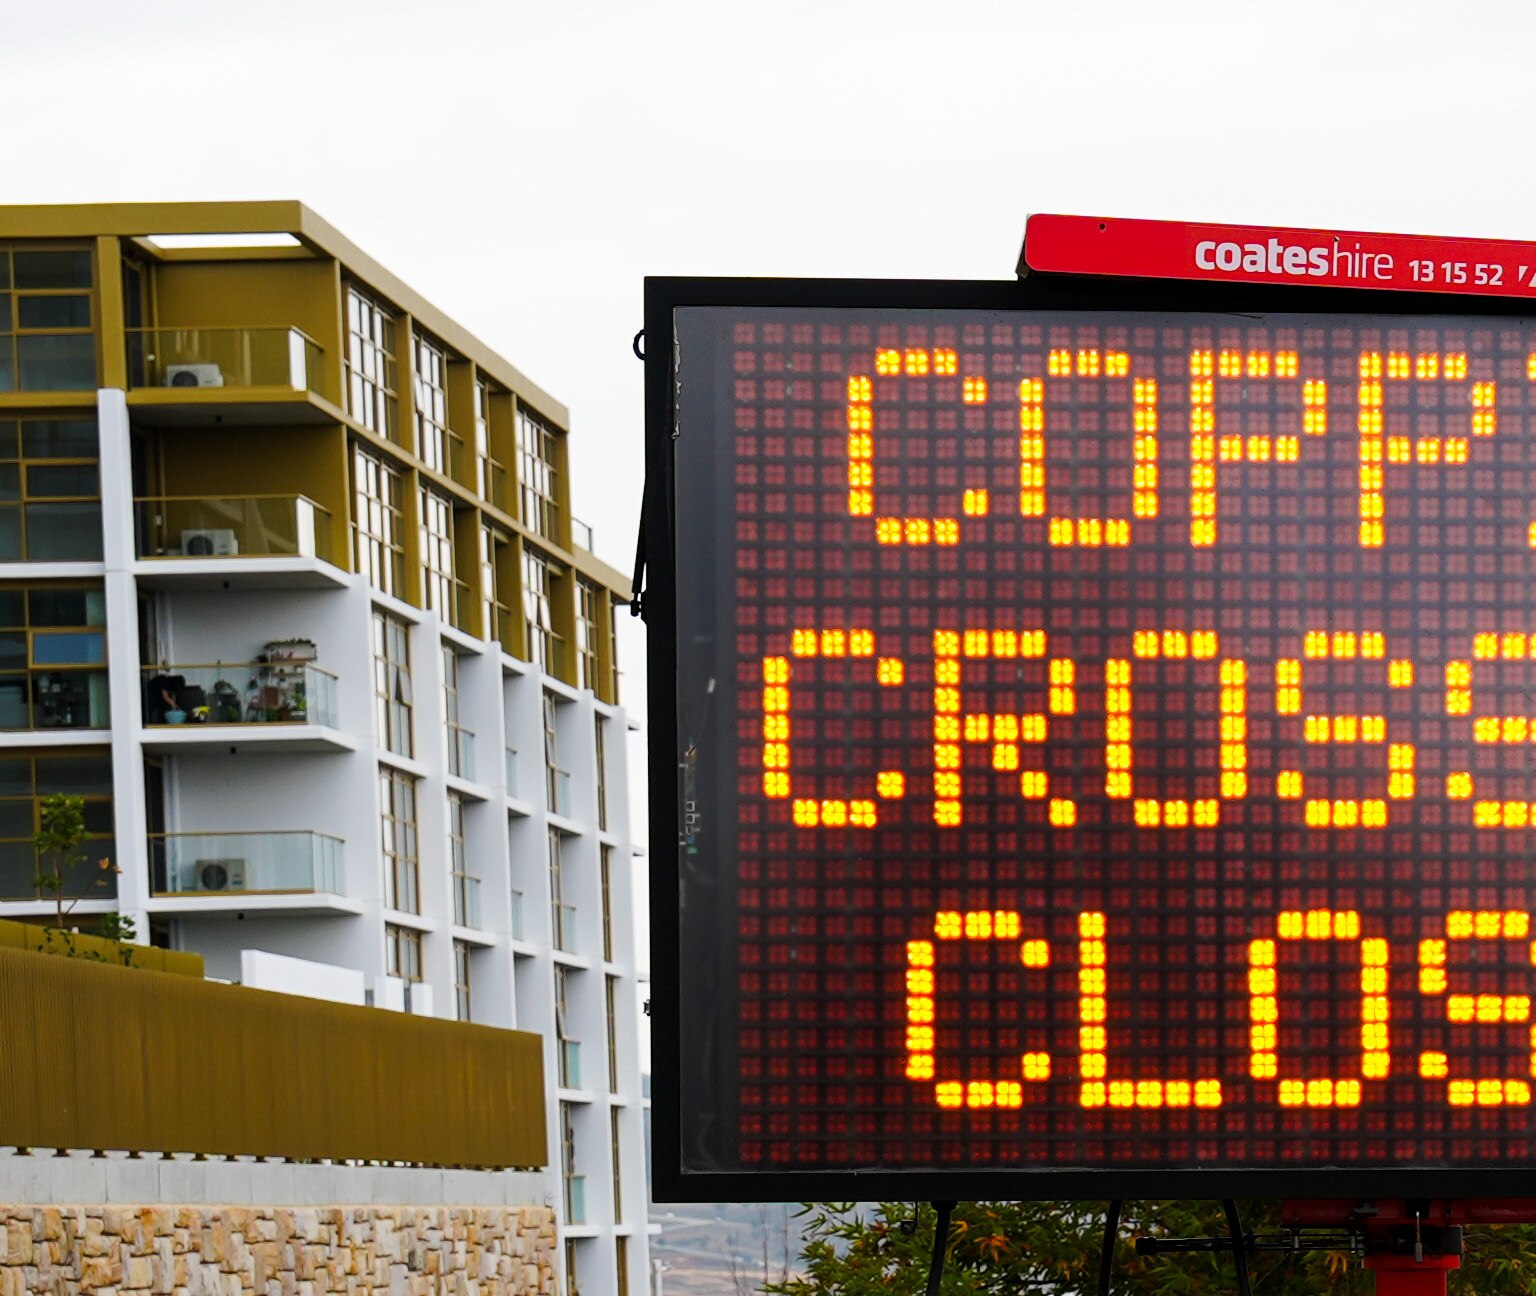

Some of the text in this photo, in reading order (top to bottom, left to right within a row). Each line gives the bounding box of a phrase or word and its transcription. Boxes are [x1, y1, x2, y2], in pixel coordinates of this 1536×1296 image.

[1195, 237, 1503, 286] coateshire 13 15 52
